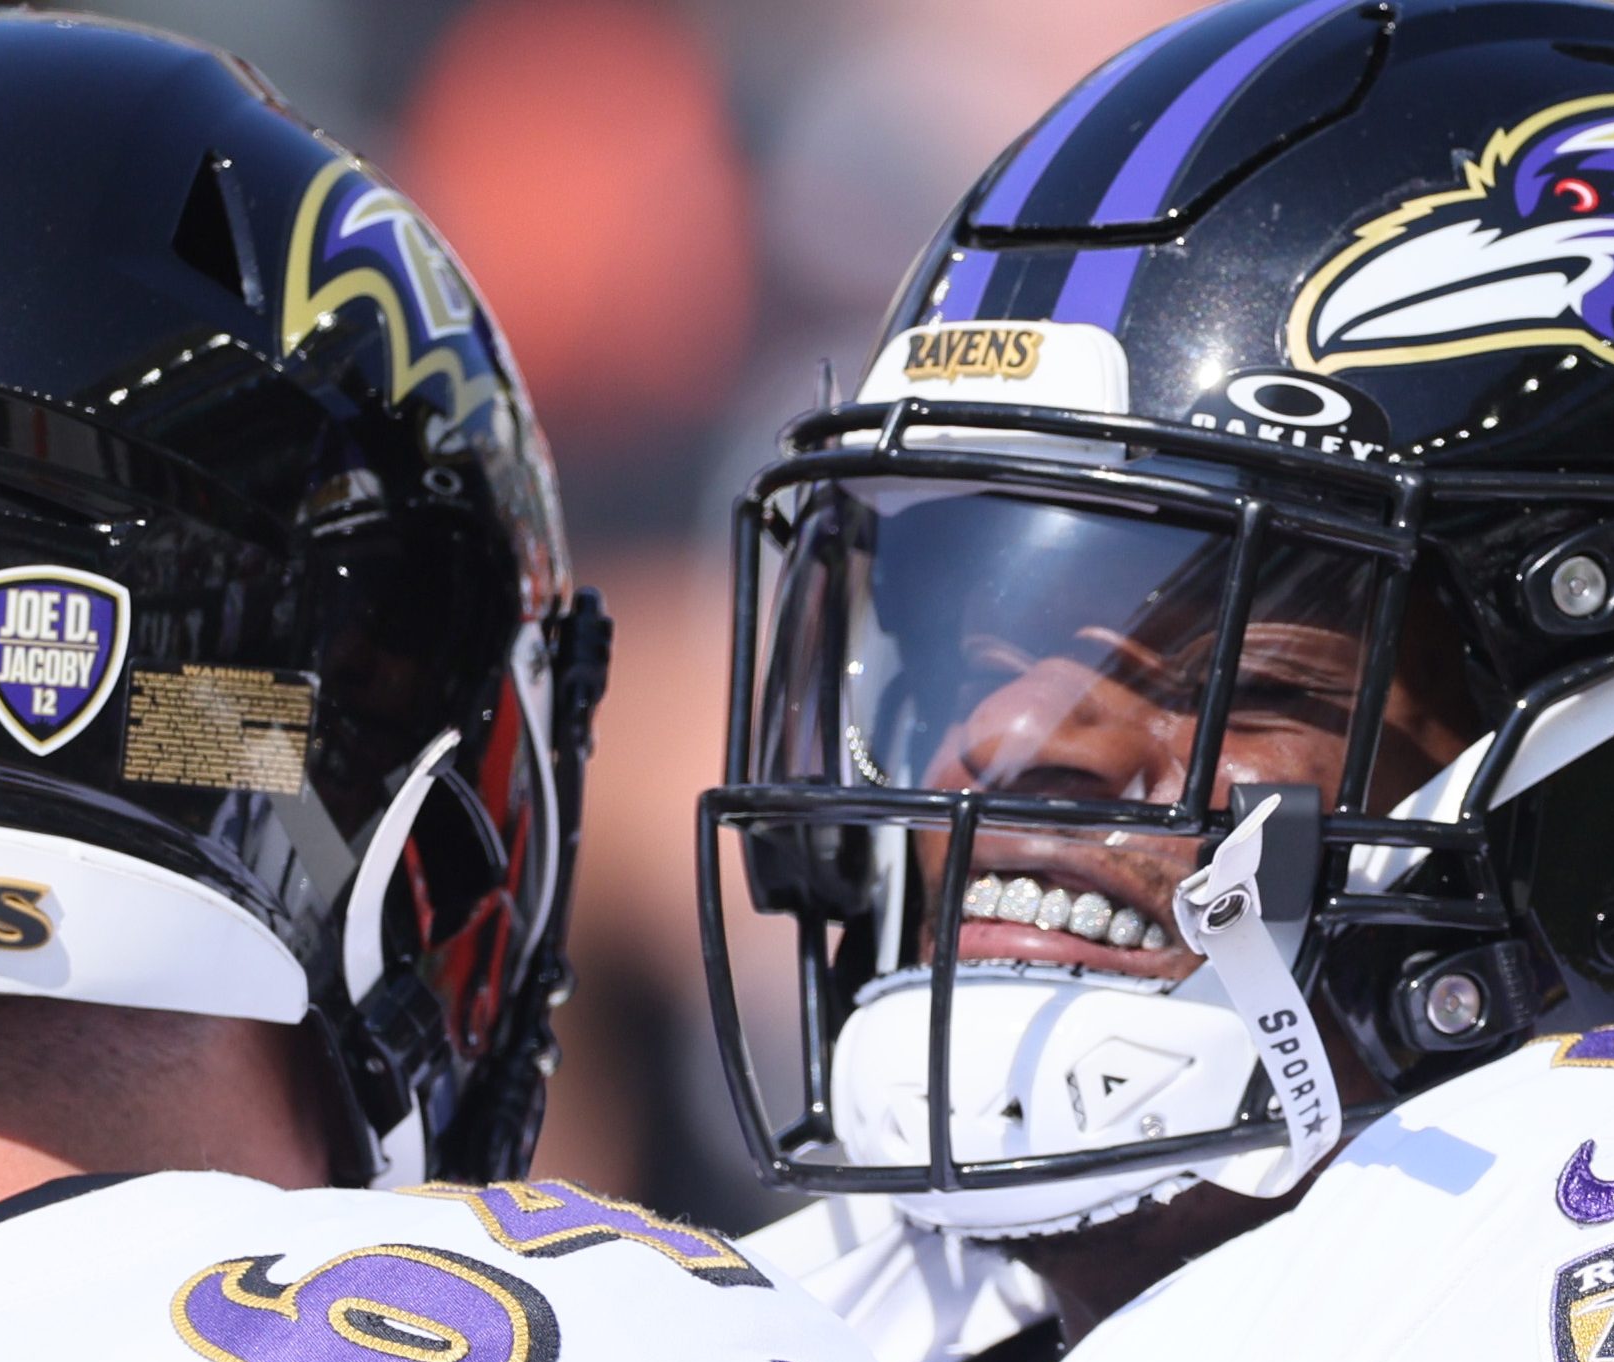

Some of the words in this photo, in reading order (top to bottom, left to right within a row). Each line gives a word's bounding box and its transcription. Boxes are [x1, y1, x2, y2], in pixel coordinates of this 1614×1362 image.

[904, 329, 1044, 384] RAVENS
[0, 588, 61, 641] JOE
[63, 593, 99, 645] D.
[182, 663, 275, 683] WARNING
[32, 686, 59, 717] 12
